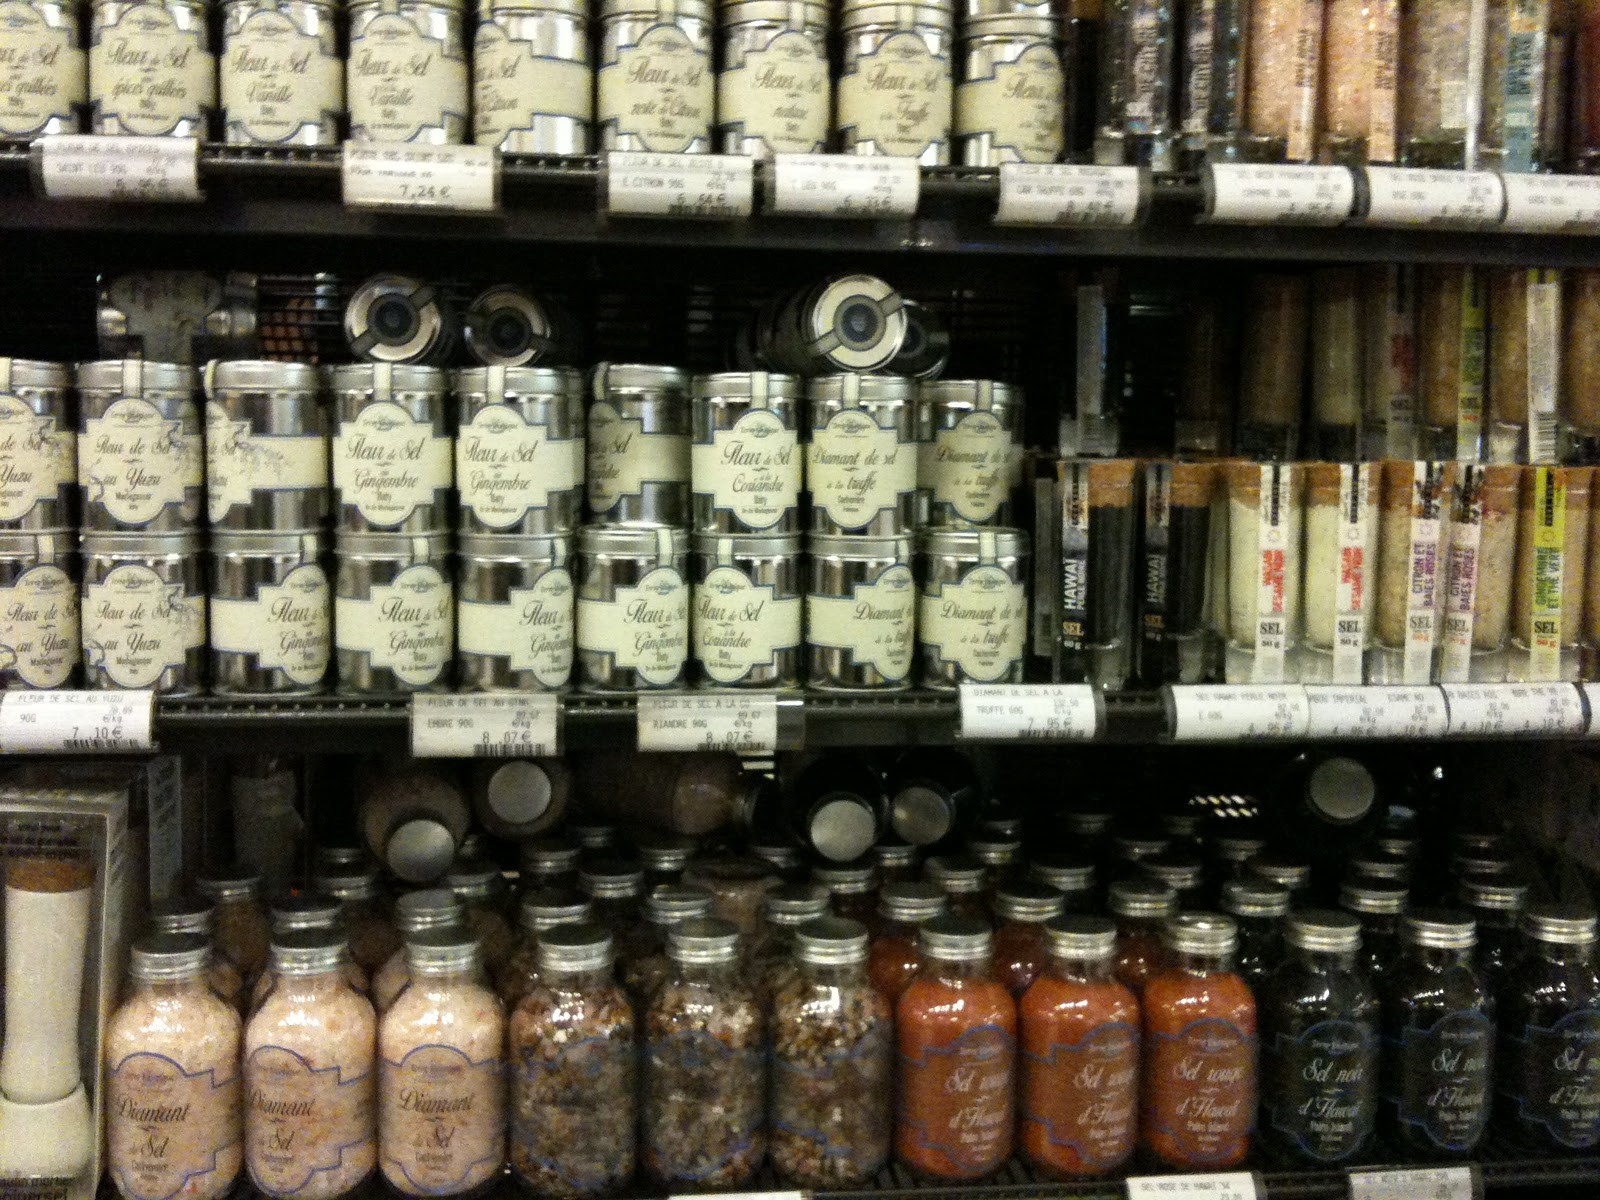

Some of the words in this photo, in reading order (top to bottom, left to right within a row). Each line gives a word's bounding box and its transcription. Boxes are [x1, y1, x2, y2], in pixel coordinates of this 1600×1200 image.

[345, 433, 384, 460] Fleur
[464, 435, 498, 463] Fleur
[720, 440, 762, 466] Fleur
[1423, 577, 1435, 607] BAIES
[378, 595, 420, 623] Fleur
[519, 600, 558, 626] Fleur
[623, 598, 665, 624] Fleur
[739, 599, 765, 622] Sel
[941, 599, 996, 621] Diamant
[1260, 621, 1284, 635] SEL
[1338, 620, 1362, 634] SEL
[1410, 616, 1432, 629] SEL
[1534, 620, 1558, 634] SEL
[119, 1097, 191, 1122] Diamant
